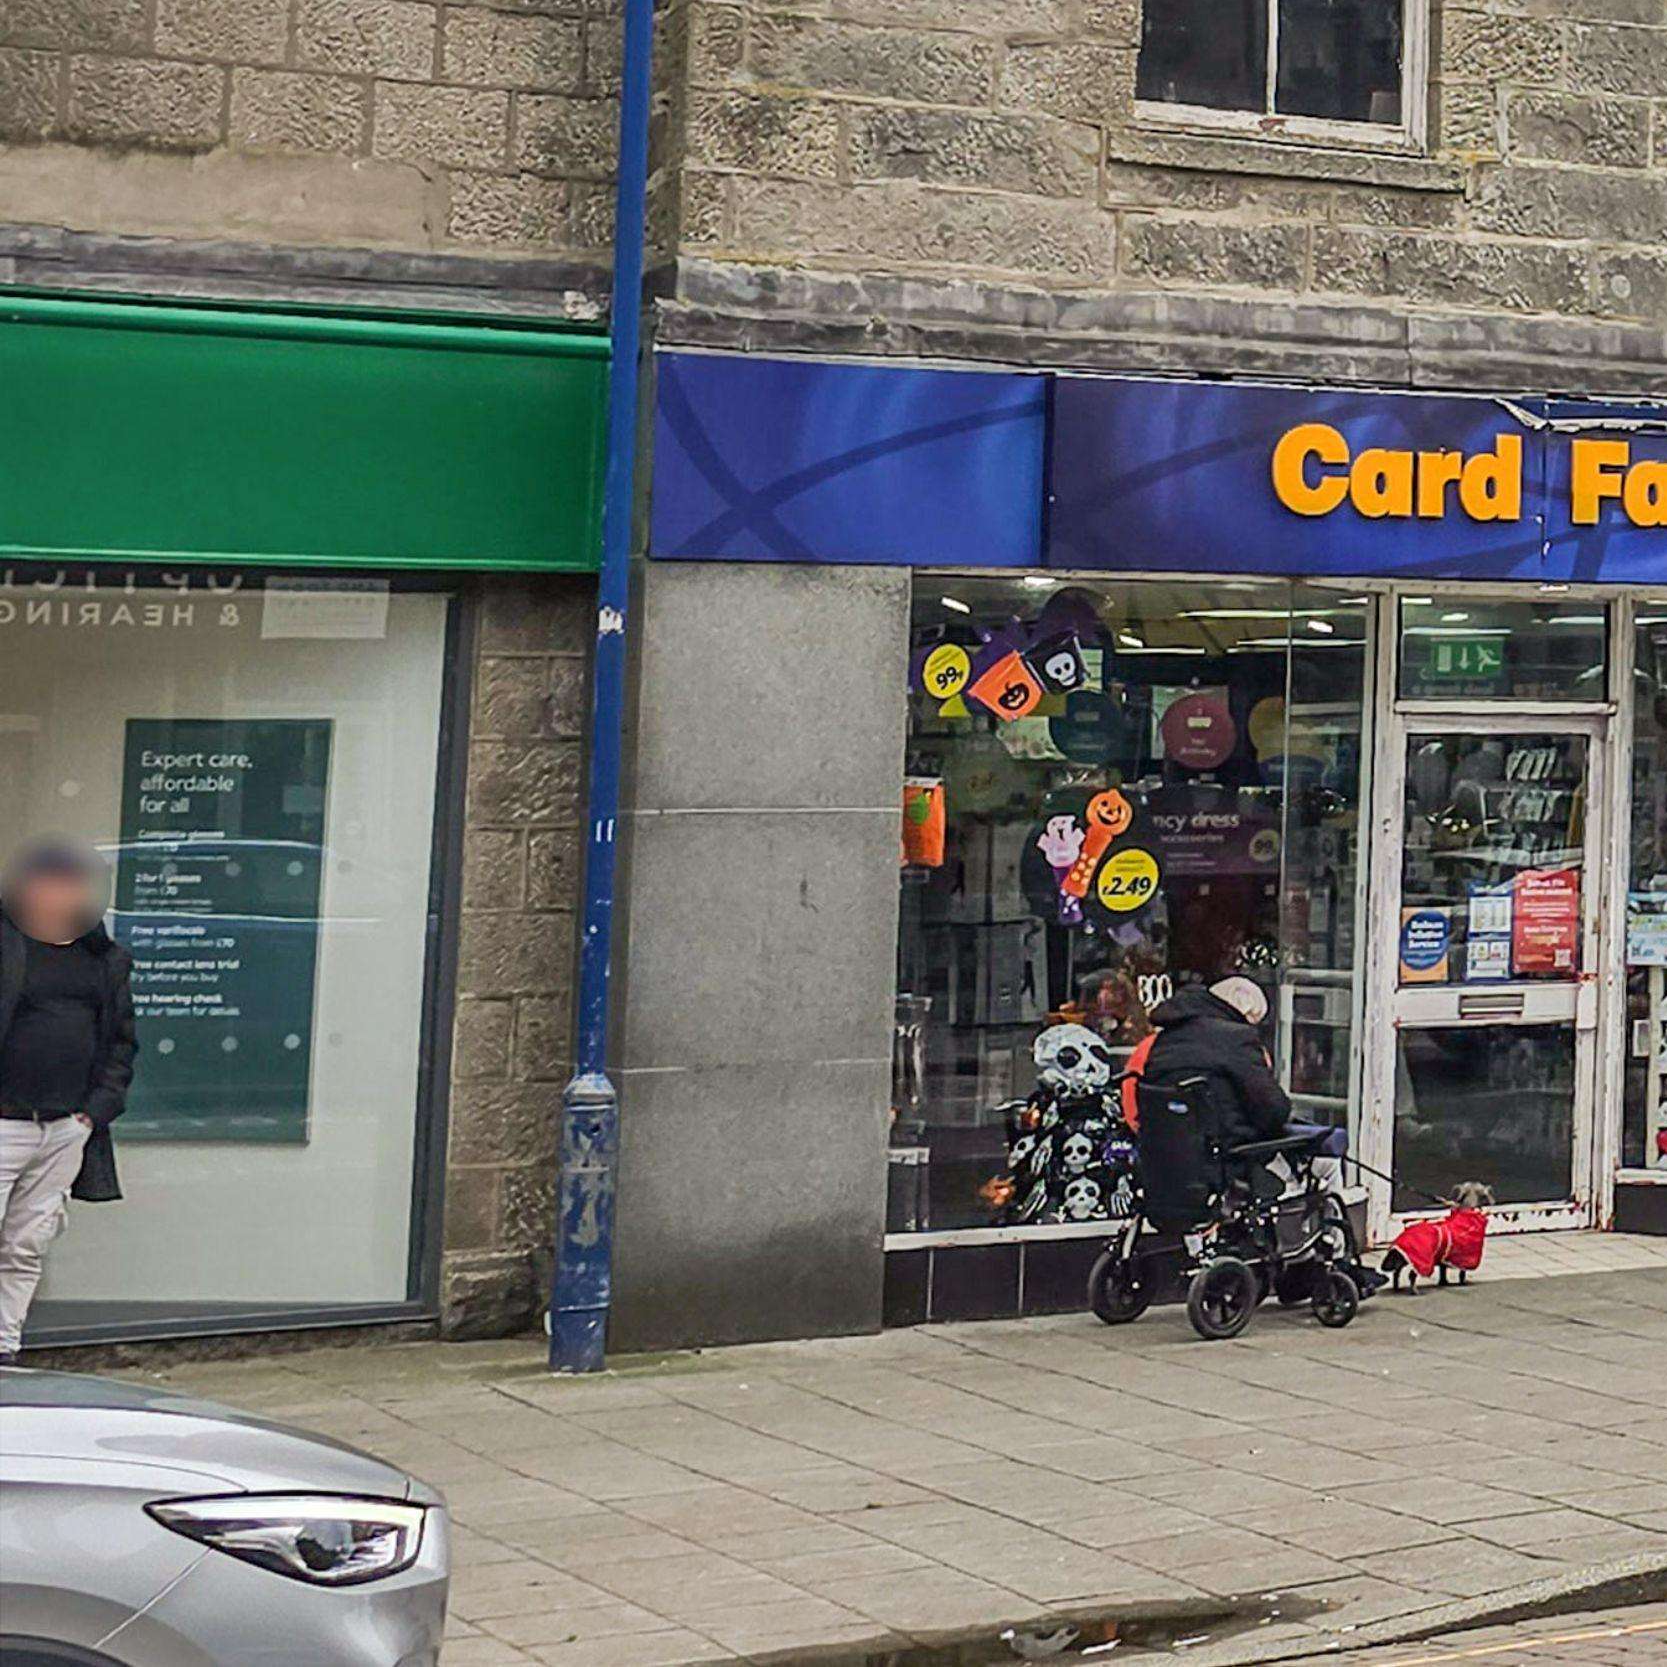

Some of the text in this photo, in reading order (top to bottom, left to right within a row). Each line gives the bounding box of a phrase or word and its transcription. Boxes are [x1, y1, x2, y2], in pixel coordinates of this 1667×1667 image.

[1273, 423, 1522, 521] Card
[142, 751, 203, 770] Expert
[140, 774, 234, 792] affordable
[140, 795, 190, 813] for all
[1153, 811, 1240, 832] ncy dress
[1102, 876, 1152, 896] £2.49
